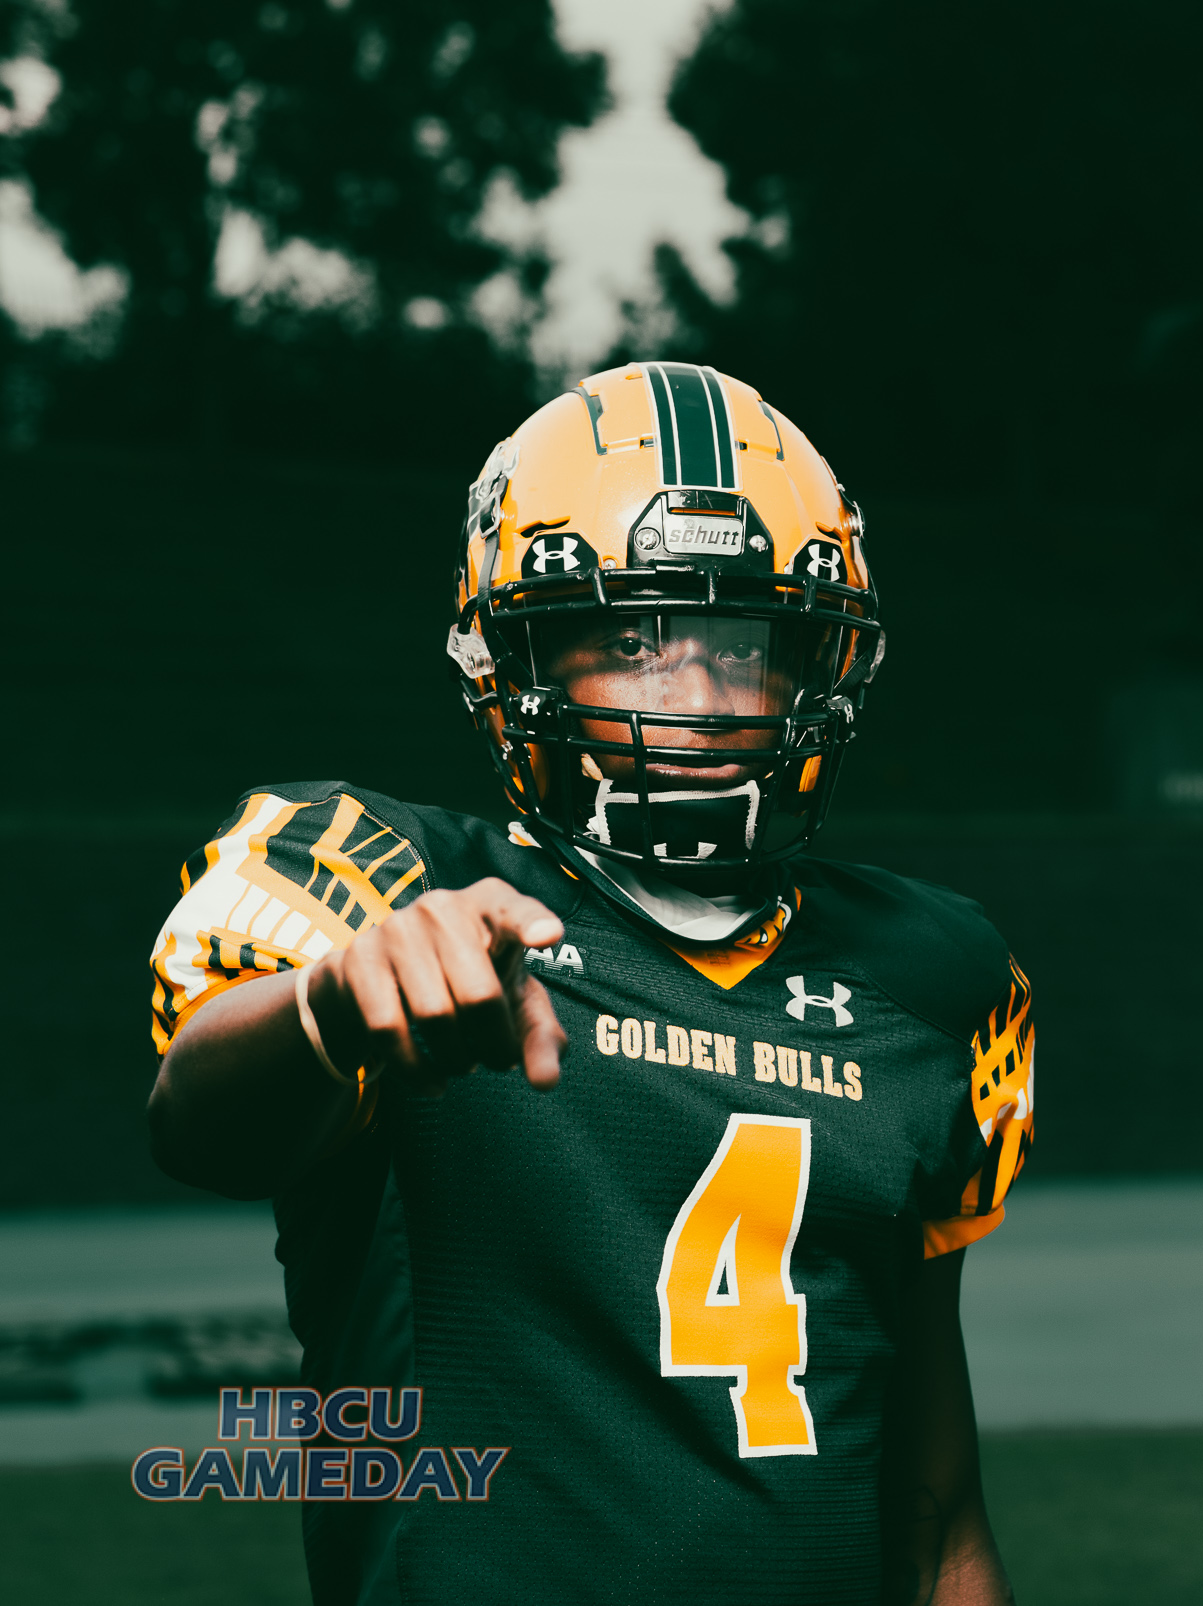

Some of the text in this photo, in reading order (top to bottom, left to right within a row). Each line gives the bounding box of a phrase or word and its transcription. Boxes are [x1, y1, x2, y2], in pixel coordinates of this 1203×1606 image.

[668, 525, 739, 546] schutt
[524, 943, 585, 975] AA
[595, 1013, 863, 1102] GOLDEN BULLS
[656, 1112, 818, 1458] 4
